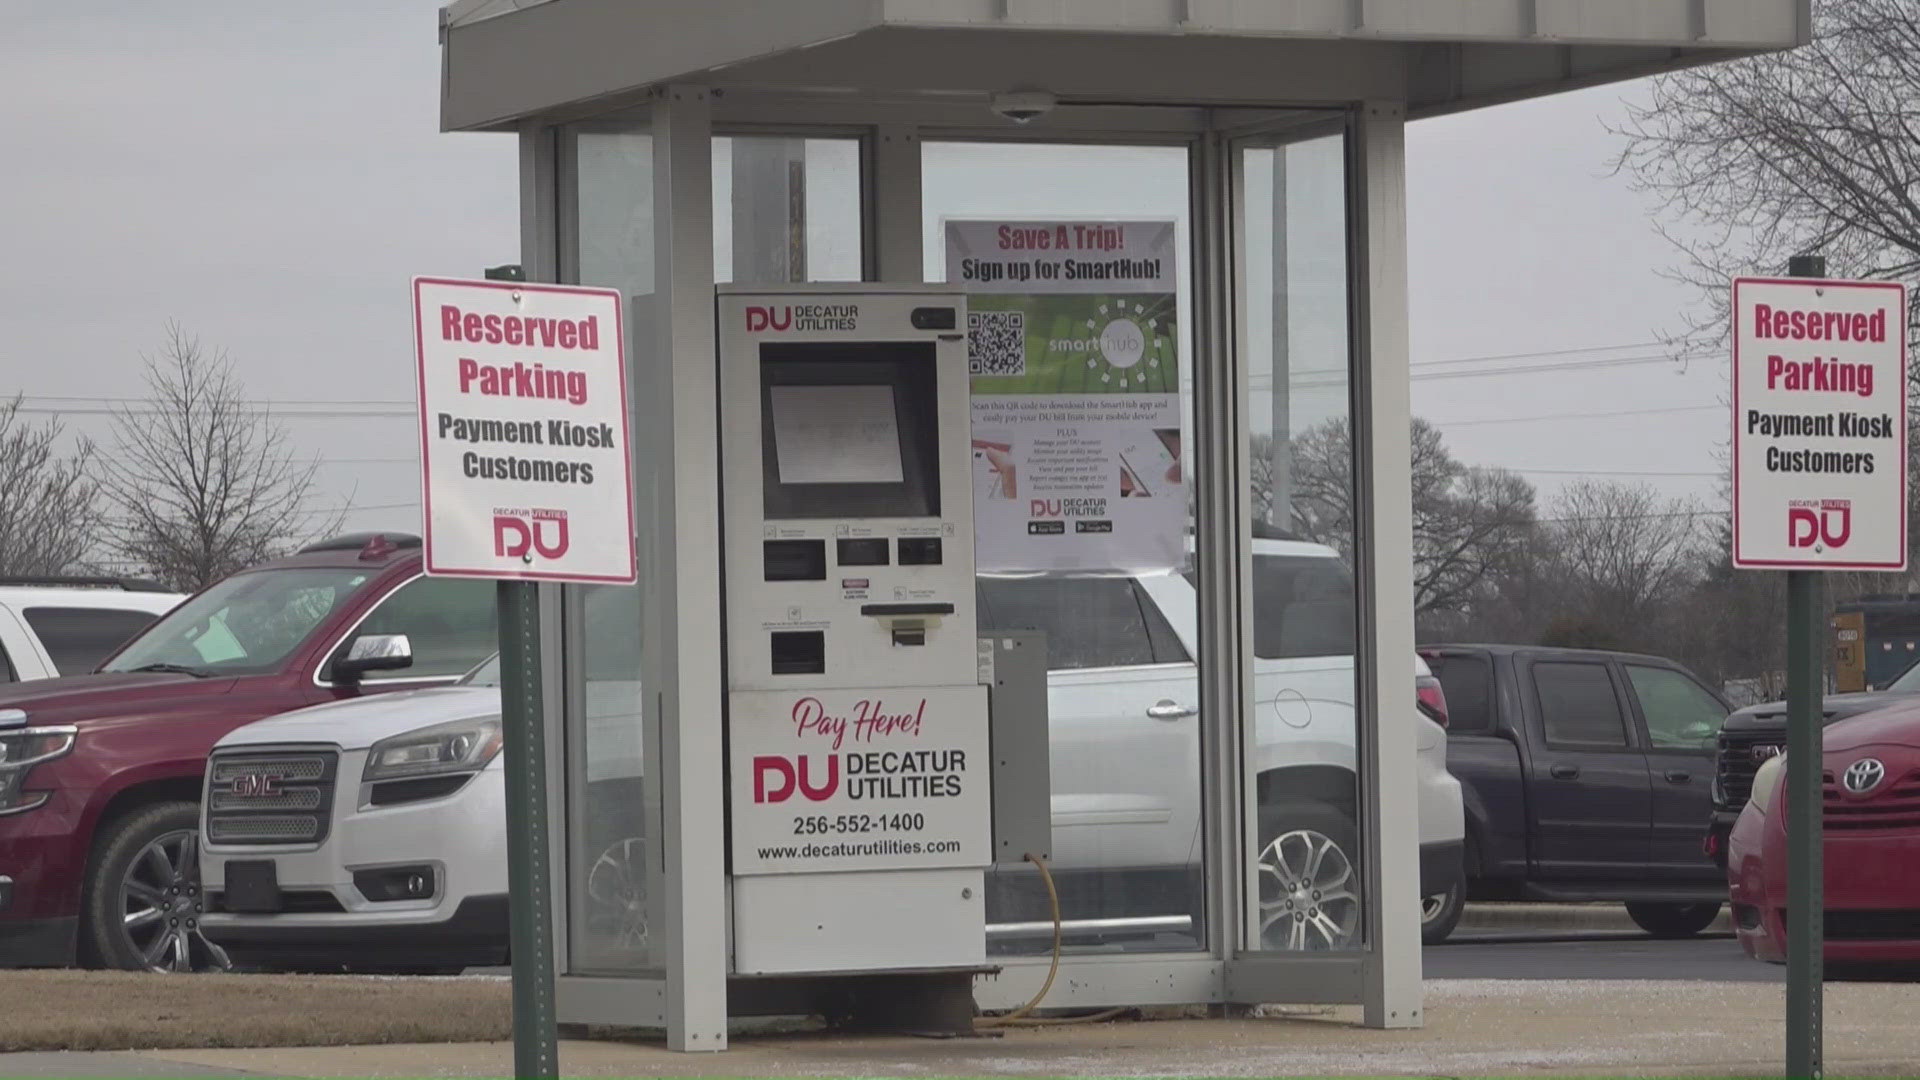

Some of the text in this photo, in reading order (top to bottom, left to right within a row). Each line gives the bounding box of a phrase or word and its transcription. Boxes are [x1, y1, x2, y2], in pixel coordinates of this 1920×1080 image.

[998, 225, 1124, 251] Save A Trip!
[962, 259, 1160, 282] Sign up for SmartHub!
[746, 306, 791, 331] DU
[795, 306, 858, 318] DECATUR
[796, 318, 856, 331] UTILITIES
[1755, 304, 1885, 343] Reserved
[441, 305, 599, 350] Reserved
[459, 358, 587, 405] Parking
[1768, 356, 1873, 397] Parking
[991, 401, 1005, 410] this
[1006, 401, 1019, 411] QR
[1020, 401, 1038, 410] code
[1048, 400, 1085, 409] download
[1087, 400, 1099, 409] the
[1139, 401, 1153, 411] app
[1154, 400, 1168, 408] and
[1005, 415, 1019, 424] pay
[1020, 415, 1036, 423] your
[1038, 413, 1052, 421] DU
[1053, 412, 1065, 421] bill
[1067, 412, 1084, 421] from
[1087, 413, 1104, 422] your
[1105, 412, 1131, 421] mobile
[438, 413, 614, 448] Payment Kiosk
[1057, 429, 1077, 437] PLUS
[1748, 410, 1893, 439] Payment Kiosk
[463, 452, 593, 484] Customers
[1766, 446, 1874, 474] Customers
[493, 507, 530, 517] DECATUR
[1031, 499, 1062, 517] DU
[1064, 498, 1106, 507] DECATUR
[1064, 507, 1105, 516] UTILITIES
[1789, 500, 1819, 508] DECATUR
[493, 516, 569, 559] DU
[1789, 508, 1850, 548] DU
[792, 697, 926, 750] Pay Here!
[847, 750, 966, 775] DECATUR
[231, 773, 284, 797] GMC
[753, 754, 839, 804] DU
[847, 775, 962, 800] UTILITIES
[793, 813, 924, 835] 256-552-1400
[758, 839, 961, 859] www.decaturutilities.com
